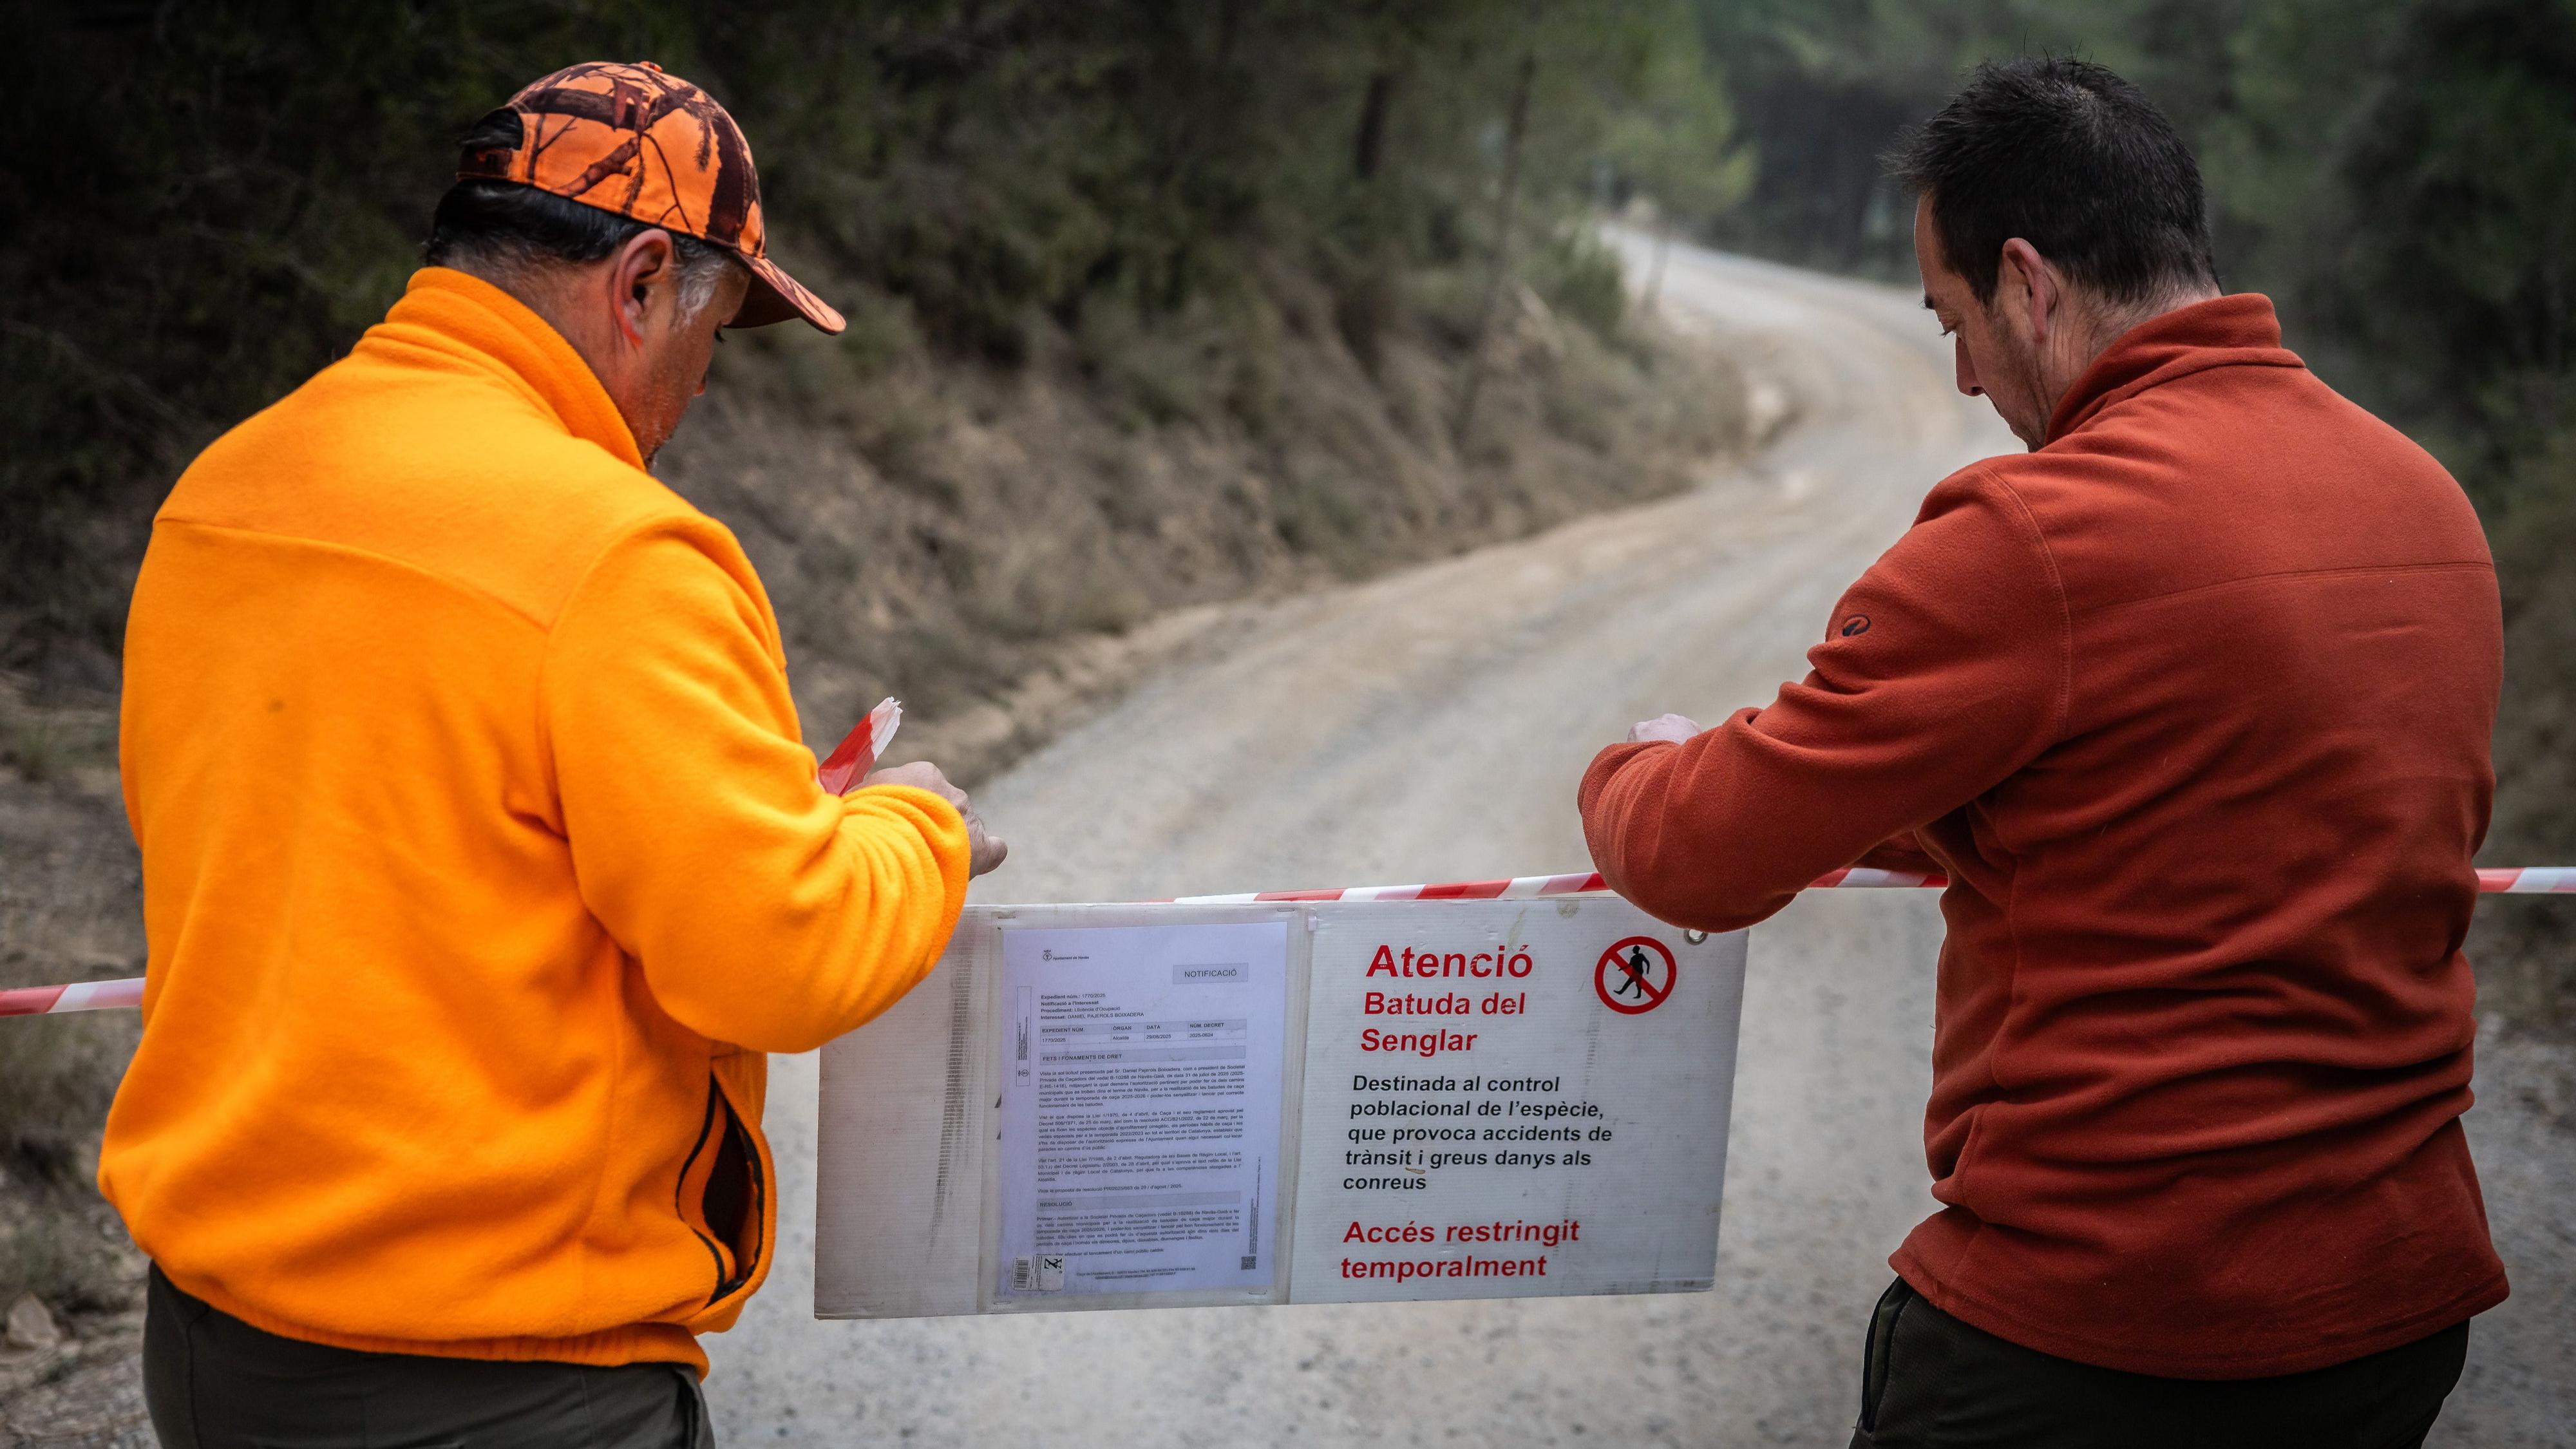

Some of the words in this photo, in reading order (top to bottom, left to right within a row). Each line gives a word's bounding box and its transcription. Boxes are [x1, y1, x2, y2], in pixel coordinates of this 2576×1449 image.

[1365, 944, 1533, 978] Atenció
[1184, 969, 1237, 978] NOTIFICACIÓ
[1364, 992, 1470, 1015] Batuda
[1481, 992, 1526, 1015] del
[1361, 1028, 1478, 1057] Senglar
[1352, 1075, 1455, 1092] Destinada
[1463, 1076, 1481, 1092] al
[1487, 1076, 1560, 1092] control
[1350, 1100, 1470, 1119] poblacional
[1477, 1101, 1502, 1116] de
[1348, 1128, 1386, 1144] que
[1392, 1128, 1475, 1144] provoca
[1482, 1125, 1580, 1141] accidents
[1588, 1126, 1613, 1141] de
[1345, 1150, 1412, 1166] trànsit
[1417, 1150, 1424, 1166] i
[1430, 1151, 1488, 1169] greus
[1495, 1150, 1555, 1170] danys
[1562, 1150, 1592, 1166] als
[1343, 1177, 1426, 1189] conreus
[1343, 1220, 1435, 1244] Accés
[1446, 1219, 1580, 1247] restringit
[1341, 1255, 1547, 1283] temporalment
